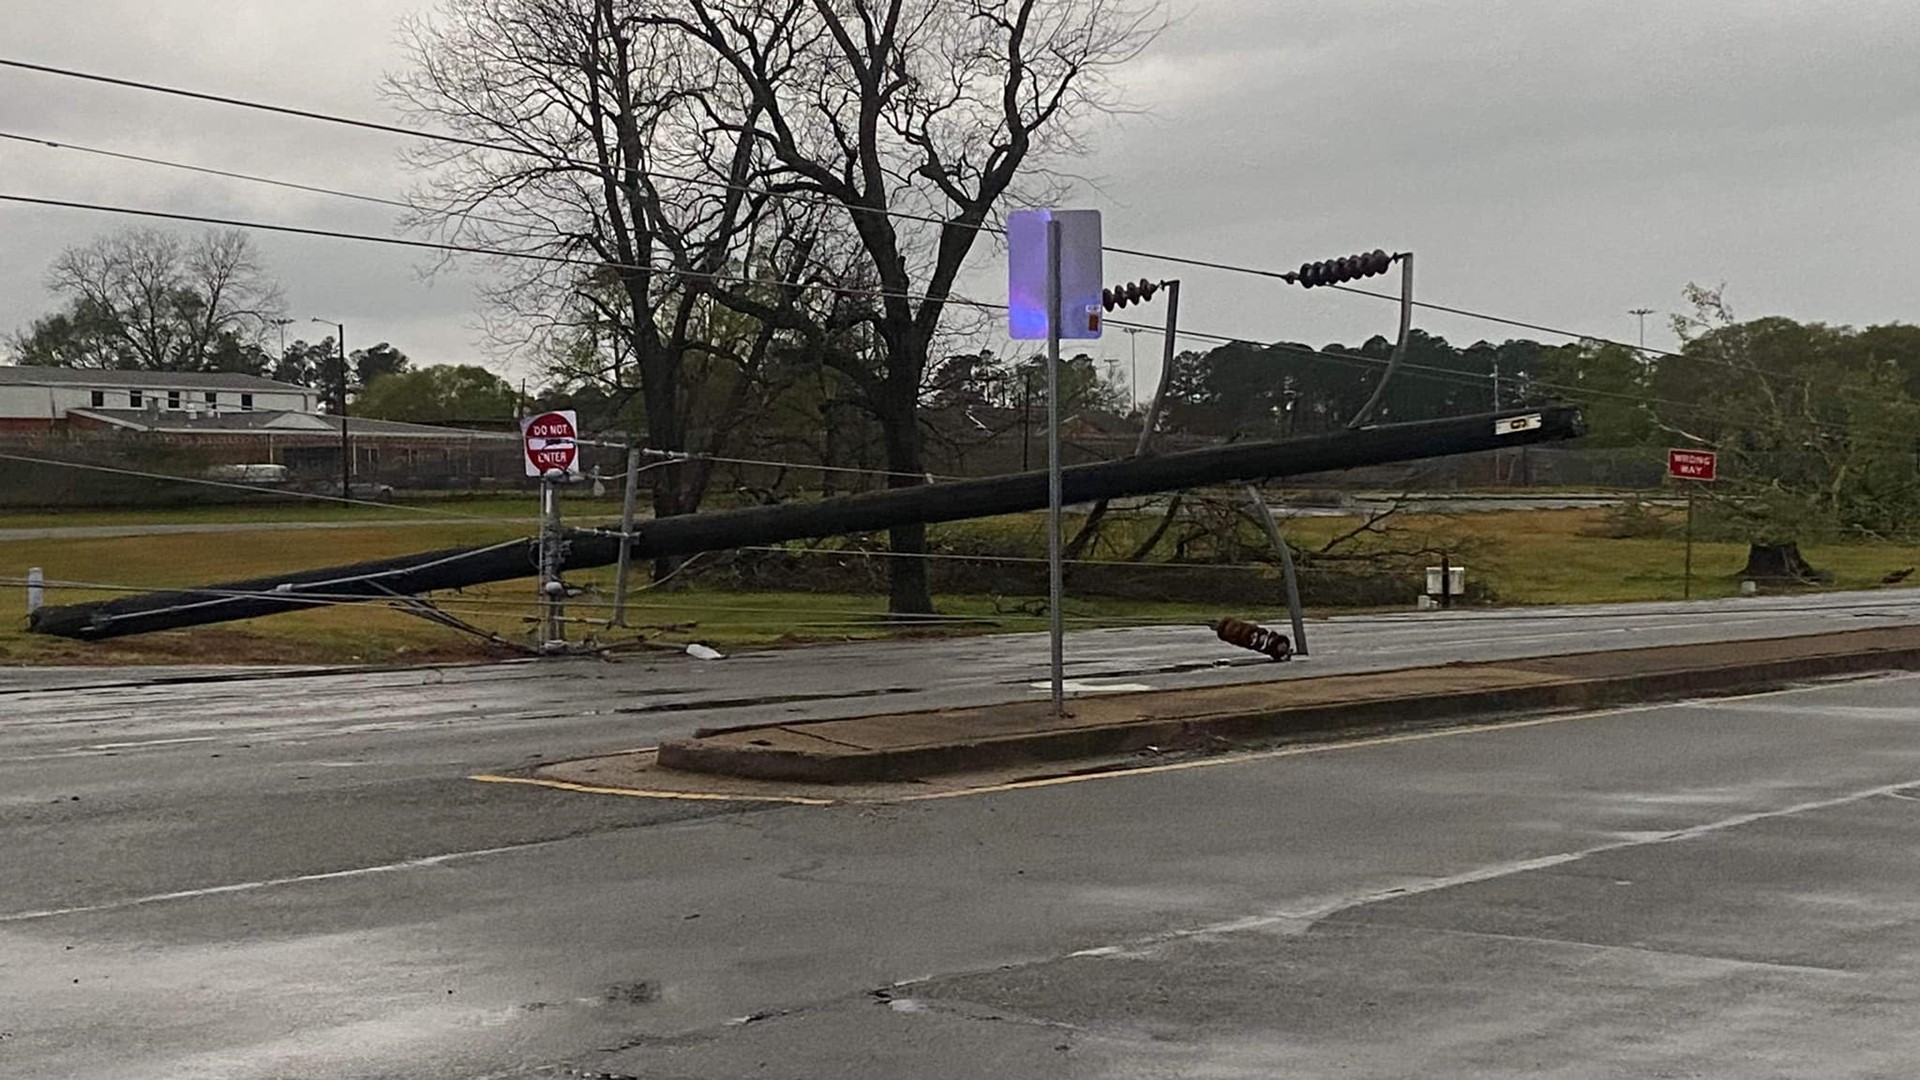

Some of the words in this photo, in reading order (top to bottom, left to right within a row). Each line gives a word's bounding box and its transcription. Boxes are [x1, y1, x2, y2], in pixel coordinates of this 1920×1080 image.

[533, 425, 547, 436] DO
[550, 424, 568, 434] NOT
[538, 451, 567, 463] ENTER
[1673, 453, 1711, 465] WRONG
[1680, 464, 1703, 475] WAY
